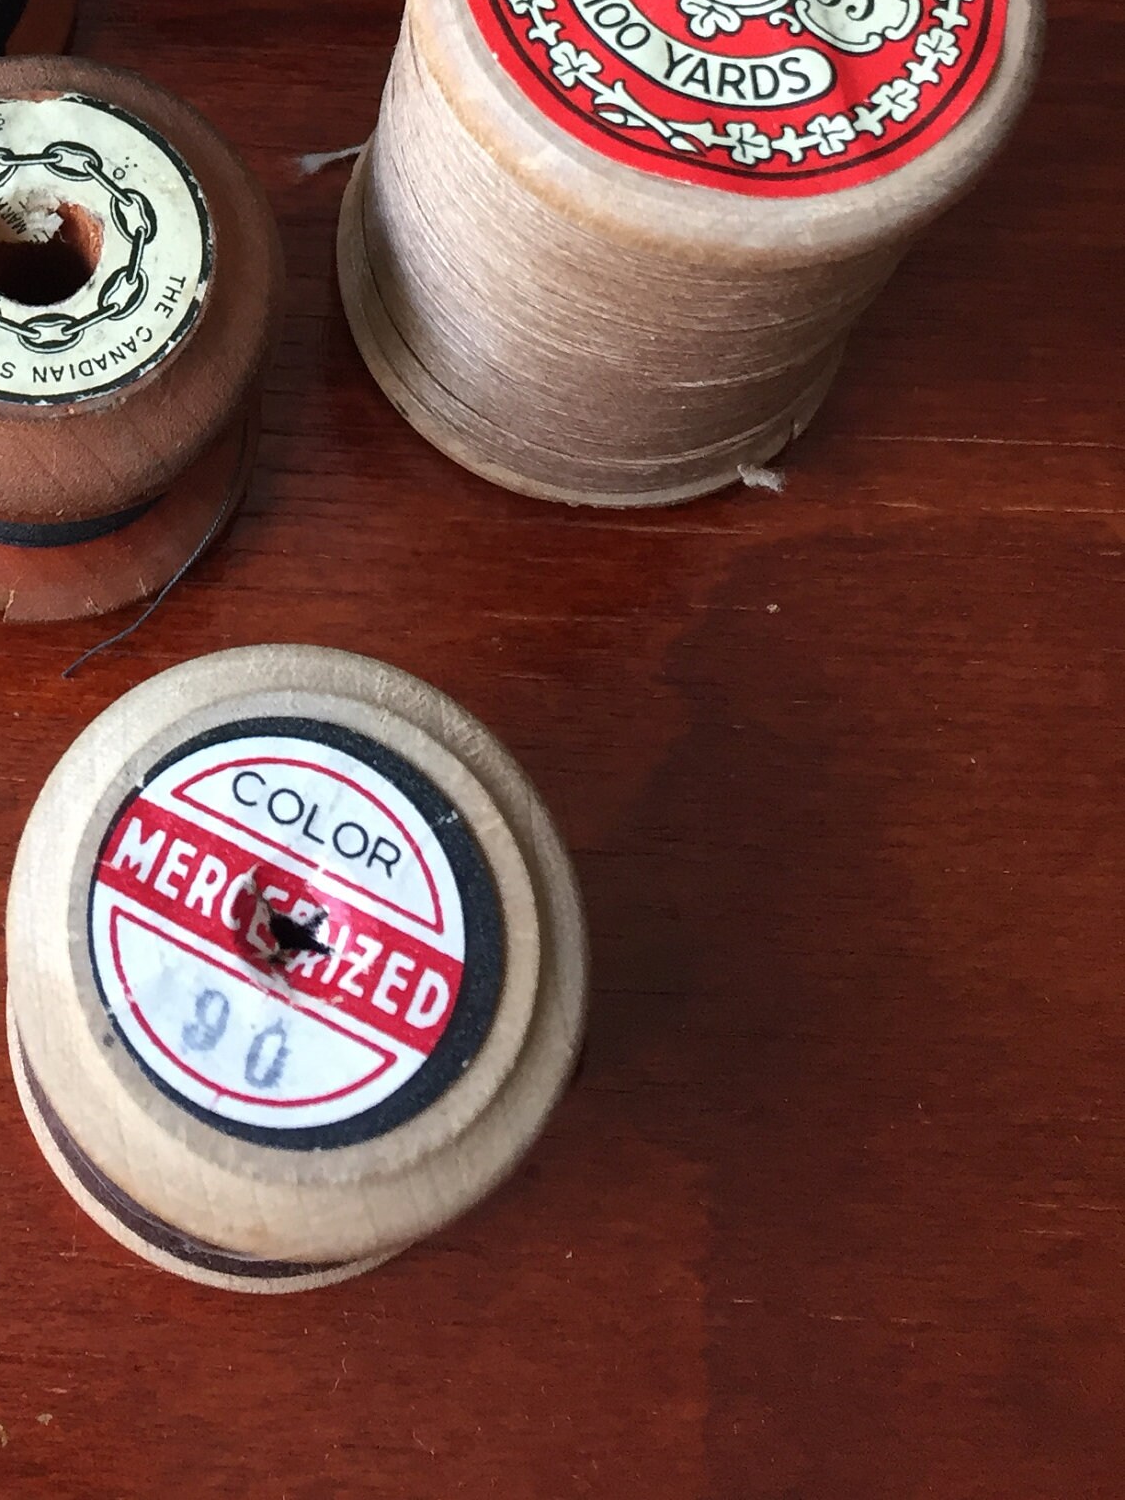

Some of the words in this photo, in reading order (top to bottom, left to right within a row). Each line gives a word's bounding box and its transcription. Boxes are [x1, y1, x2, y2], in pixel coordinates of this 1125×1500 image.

[662, 42, 813, 102] YARDS
[153, 273, 187, 320] THE
[31, 325, 154, 383] CANADIAN
[231, 770, 402, 879] COLOR
[181, 988, 290, 1090] 90
